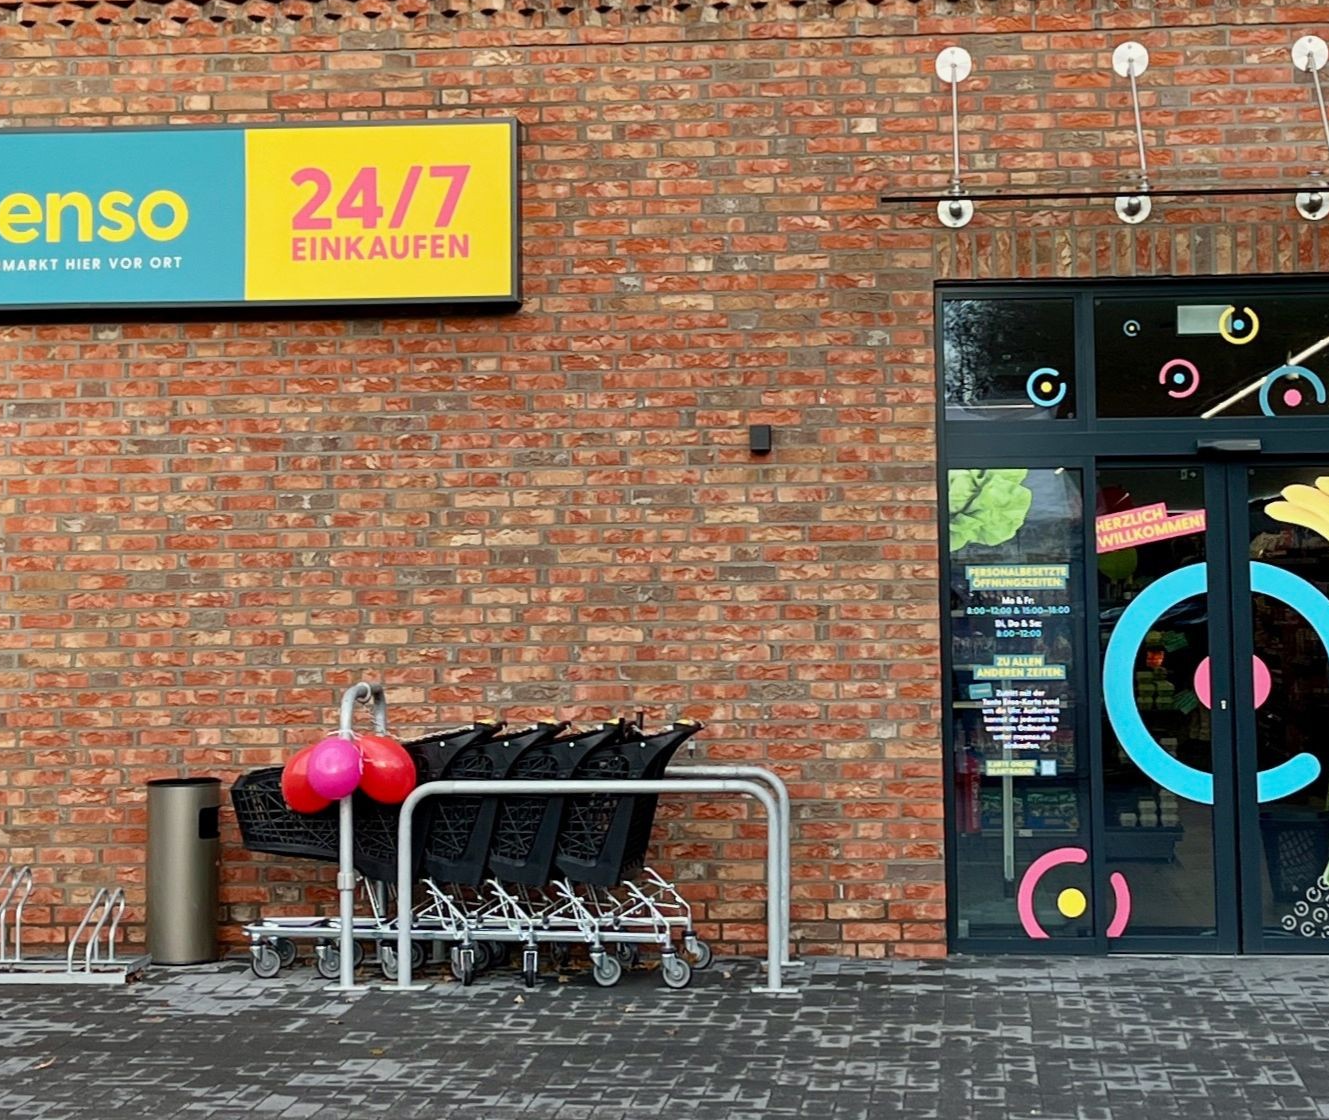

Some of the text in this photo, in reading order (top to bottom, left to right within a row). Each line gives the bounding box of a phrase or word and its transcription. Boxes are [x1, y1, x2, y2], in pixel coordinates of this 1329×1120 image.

[290, 164, 472, 231] 24/7
[292, 234, 470, 262] EINKAUFEN
[65, 257, 101, 270] HIER
[108, 257, 143, 270] VOR
[149, 256, 182, 269] ORT
[1096, 507, 1164, 532] HERZLICH
[1097, 514, 1204, 548] WILLKOMMEN!
[968, 567, 1067, 577] PERSONALBESETZTE
[996, 657, 1042, 666] ZU ALLEN
[976, 668, 1025, 677] ANDEREN
